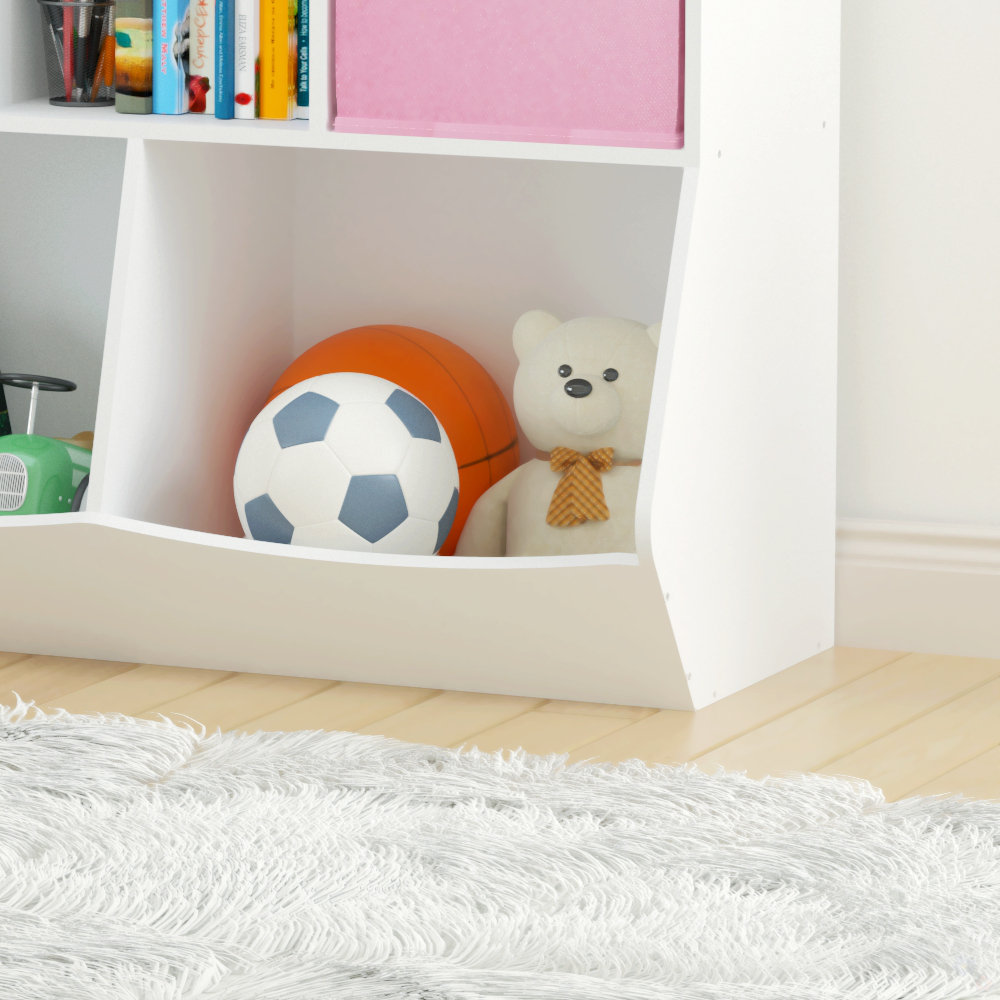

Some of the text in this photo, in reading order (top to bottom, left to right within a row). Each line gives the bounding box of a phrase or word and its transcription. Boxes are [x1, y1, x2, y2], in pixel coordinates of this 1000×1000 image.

[239, 14, 247, 34] ELIZA
[300, 46, 308, 60] Cells
[300, 61, 308, 74] Your
[300, 81, 308, 92] Talk
